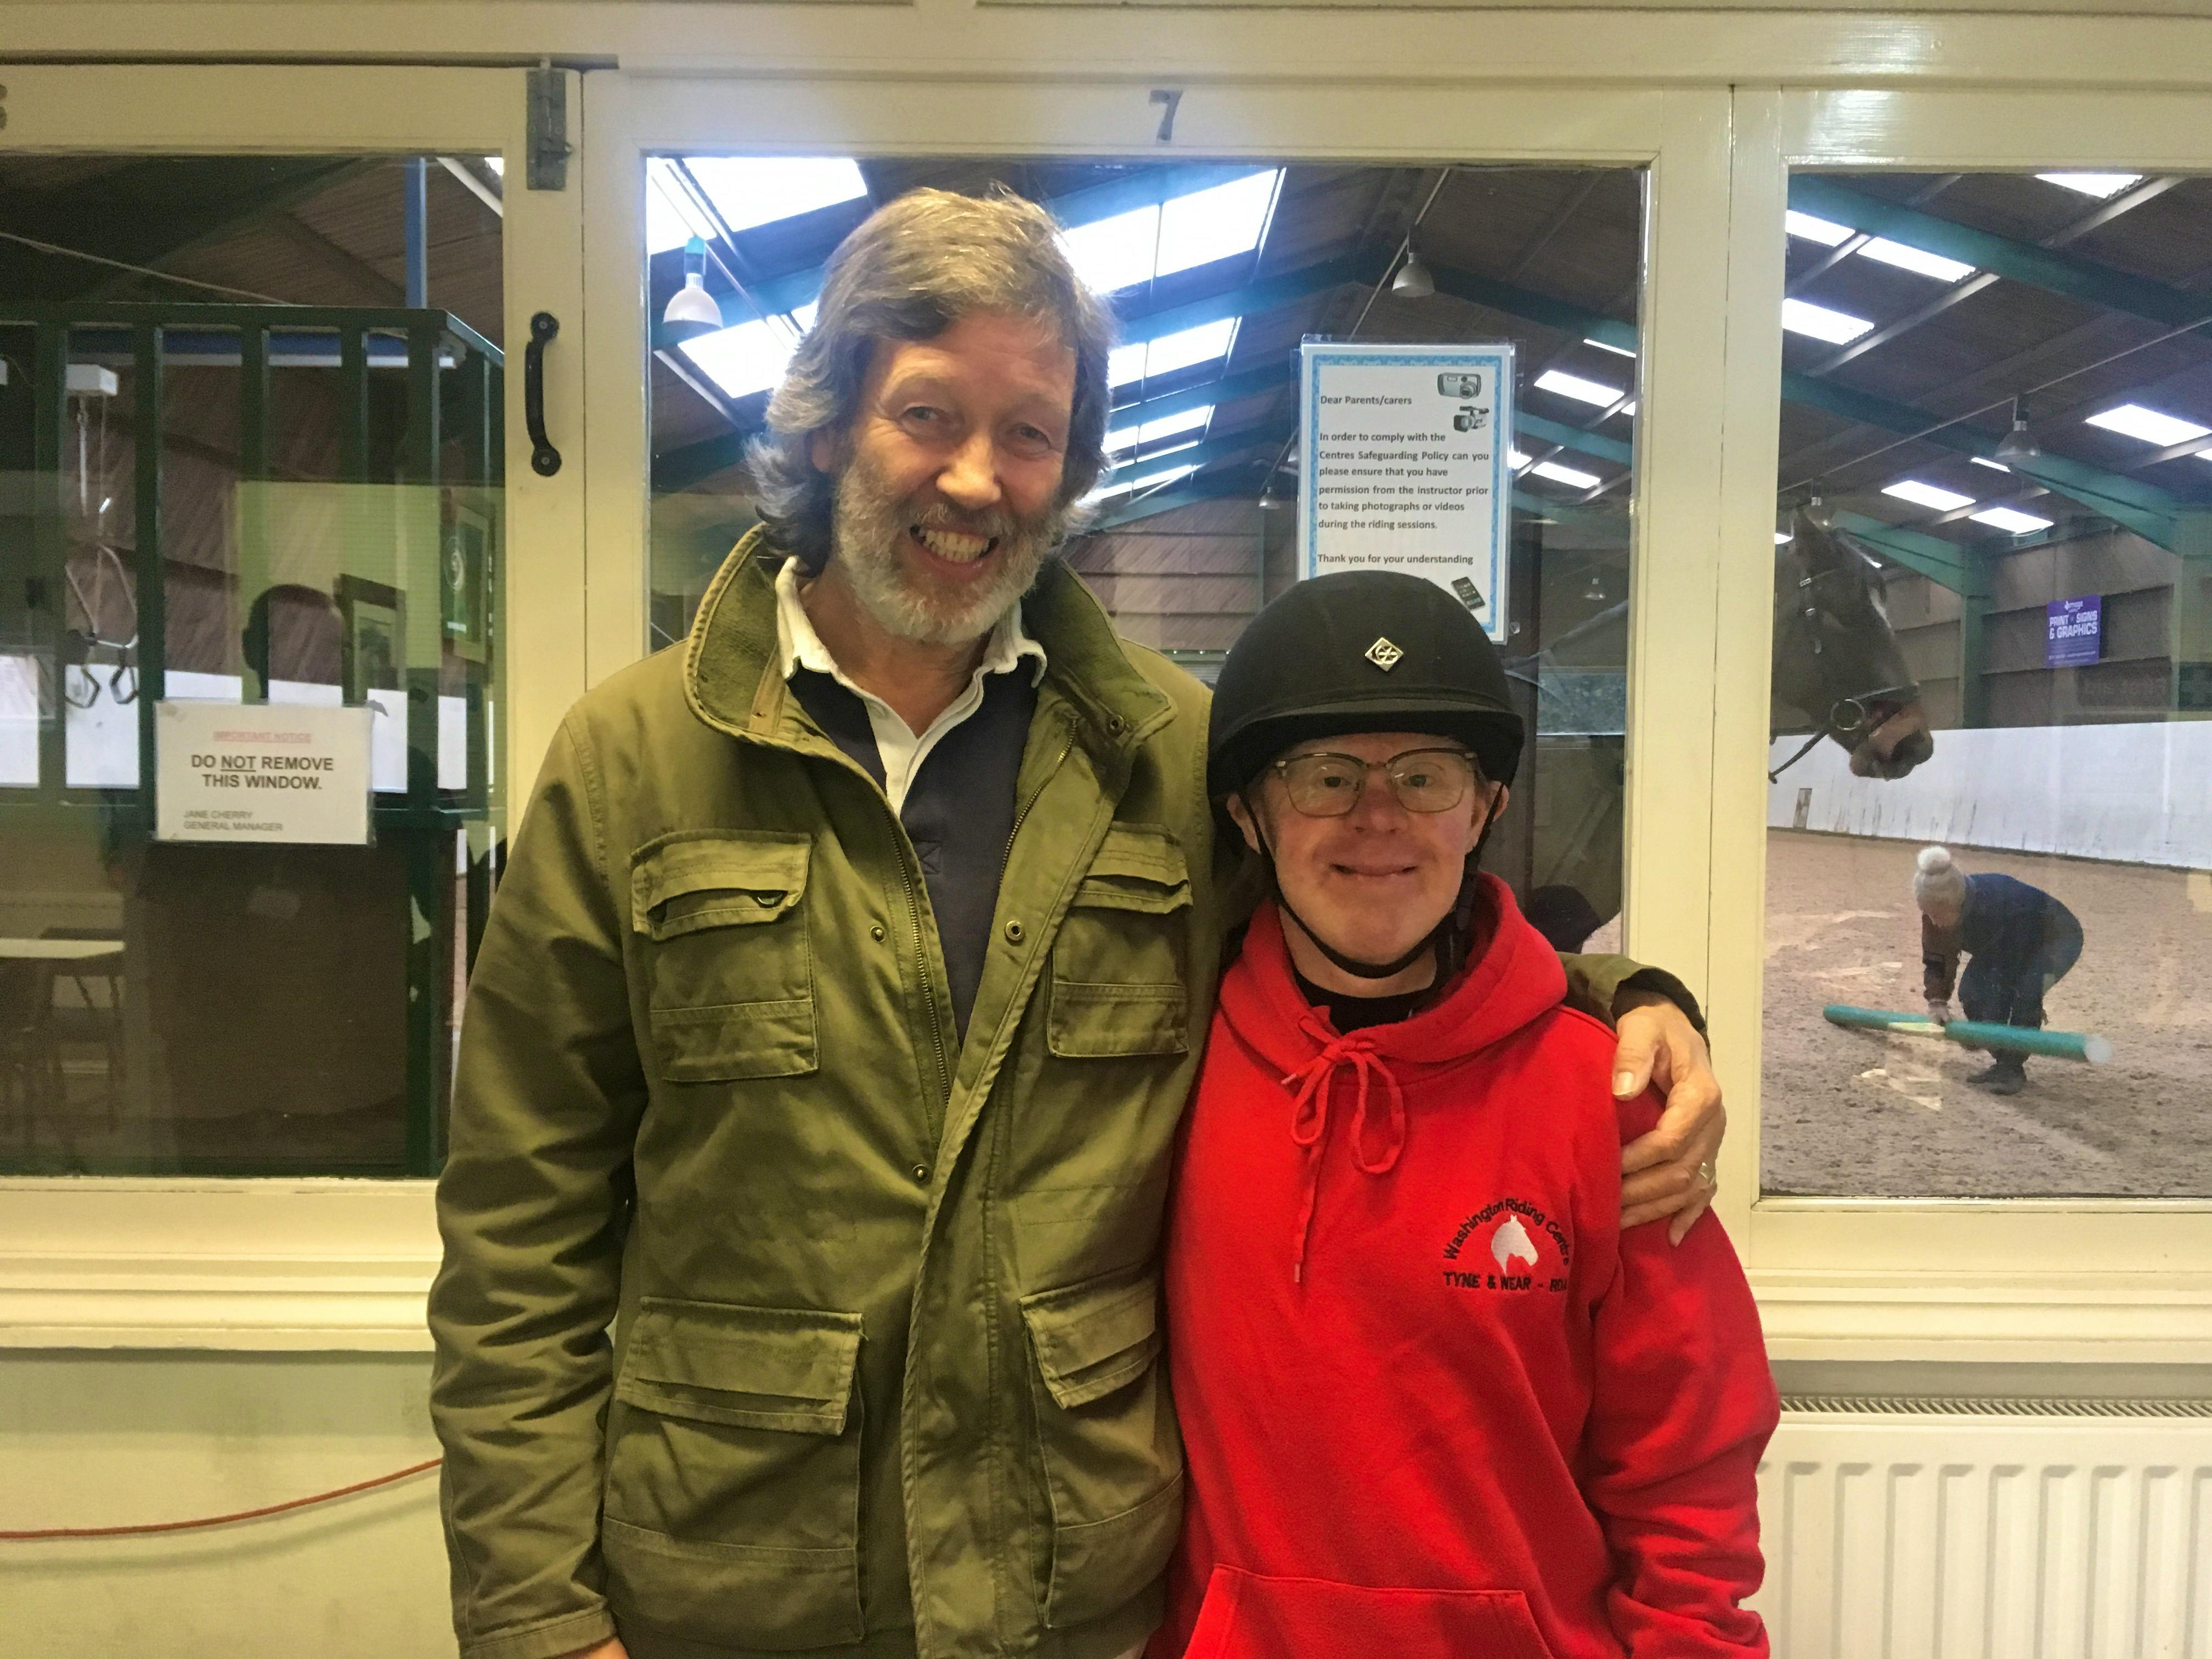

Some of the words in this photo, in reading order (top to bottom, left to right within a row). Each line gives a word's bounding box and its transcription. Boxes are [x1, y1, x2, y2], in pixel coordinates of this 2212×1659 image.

[1149, 90, 1183, 141] 7
[1320, 394, 1343, 404] Dear
[1345, 394, 1412, 406] Parents/carers
[1319, 432, 1329, 441] In
[1331, 432, 1357, 442] order
[1358, 432, 1369, 442] to
[1370, 432, 1405, 444] comply
[1407, 432, 1428, 442] with
[1430, 432, 1446, 442] the
[1319, 450, 1355, 460] Centres
[1358, 450, 1418, 462] Safeguarding
[1421, 450, 1449, 462] Policy
[1471, 453, 1489, 462] you
[1319, 466, 1349, 477] please
[1351, 468, 1383, 476] ensure
[1385, 466, 1405, 476] that
[1406, 469, 1424, 478] you
[1426, 467, 1448, 477] have
[1319, 485, 1370, 496] permission
[1372, 484, 1395, 495] from
[1398, 485, 1414, 495] the
[1417, 486, 1463, 495] instructor
[1465, 486, 1489, 497] prior
[1318, 502, 1329, 510] to
[1330, 501, 1359, 512] taking
[1361, 501, 1420, 513] photographs
[1434, 501, 1465, 511] videos
[1318, 519, 1348, 531] during
[1350, 519, 1367, 529] the
[1368, 519, 1395, 531] riding
[1397, 520, 1438, 529] sessions.
[1317, 553, 1346, 563] Thank
[1348, 556, 1365, 565] you
[1367, 554, 1382, 563] for
[1383, 556, 1405, 565] your
[1407, 554, 1474, 566] understanding
[2050, 614, 2069, 627] PRINT
[2076, 610, 2097, 623] SIGNS
[2050, 628, 2055, 640] &
[2057, 622, 2097, 638] GRAPHICS
[190, 754, 217, 769] DO
[221, 755, 257, 770] NOT
[261, 755, 334, 772] REMOVE
[201, 774, 240, 788] THIS
[244, 775, 323, 791] WINDOW.
[184, 810, 208, 819] JANE
[211, 810, 253, 819] CHERRY
[183, 821, 230, 830] GENERAL
[232, 822, 283, 832] MANAGER
[1443, 1201, 1504, 1260] Washington
[1505, 1198, 1545, 1226] Riding
[1443, 1271, 1480, 1288] TYNE
[1487, 1276, 1496, 1290] &
[1500, 1277, 1532, 1291] WEAR
